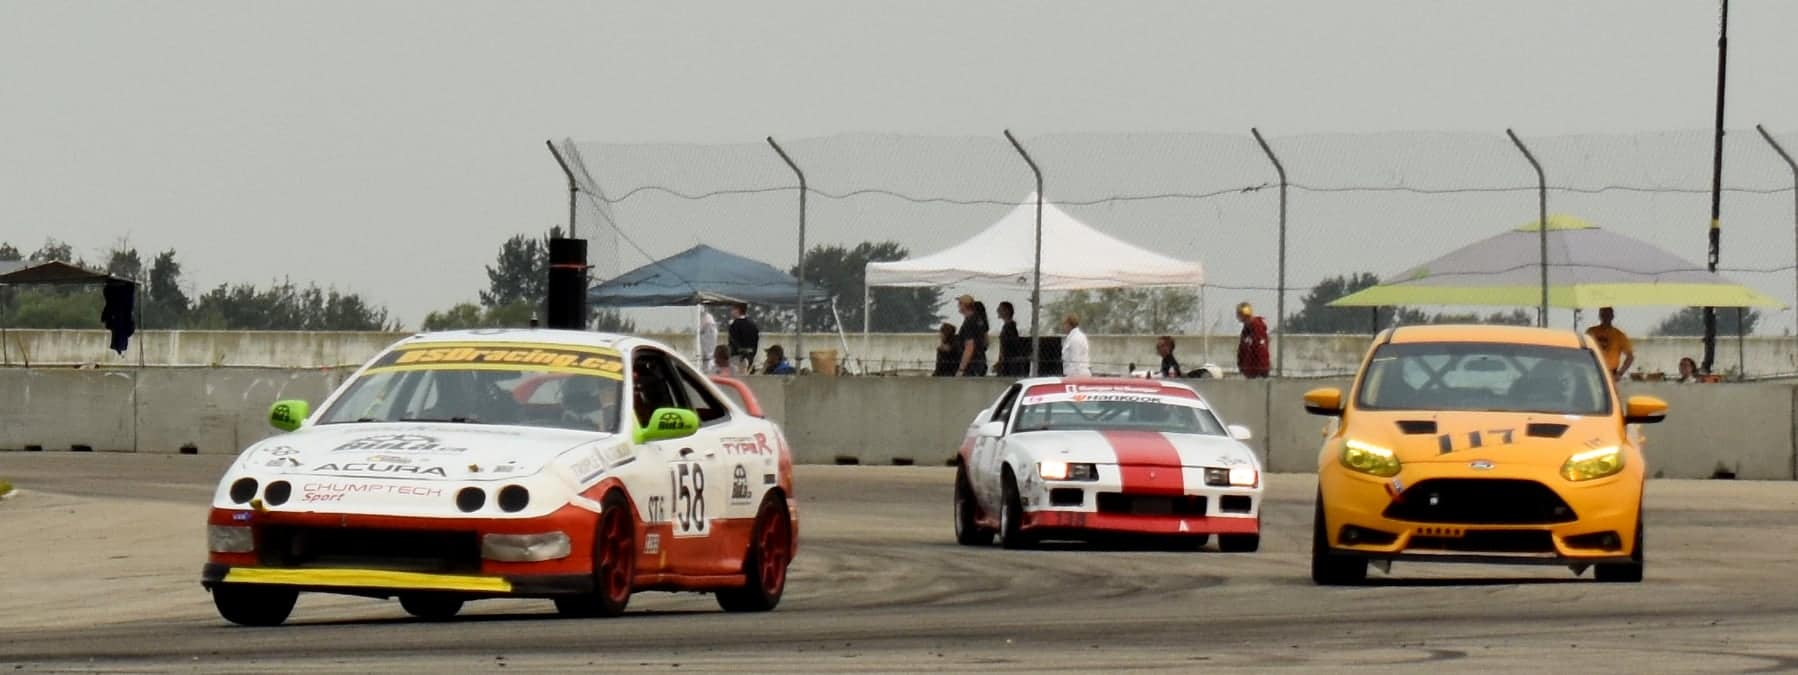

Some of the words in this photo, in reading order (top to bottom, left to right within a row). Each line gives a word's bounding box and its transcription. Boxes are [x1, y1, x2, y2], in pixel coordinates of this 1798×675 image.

[313, 462, 447, 478] ACURA
[301, 491, 345, 503] Sport
[302, 481, 442, 497] CHUMPTECH
[670, 462, 705, 532] 158
